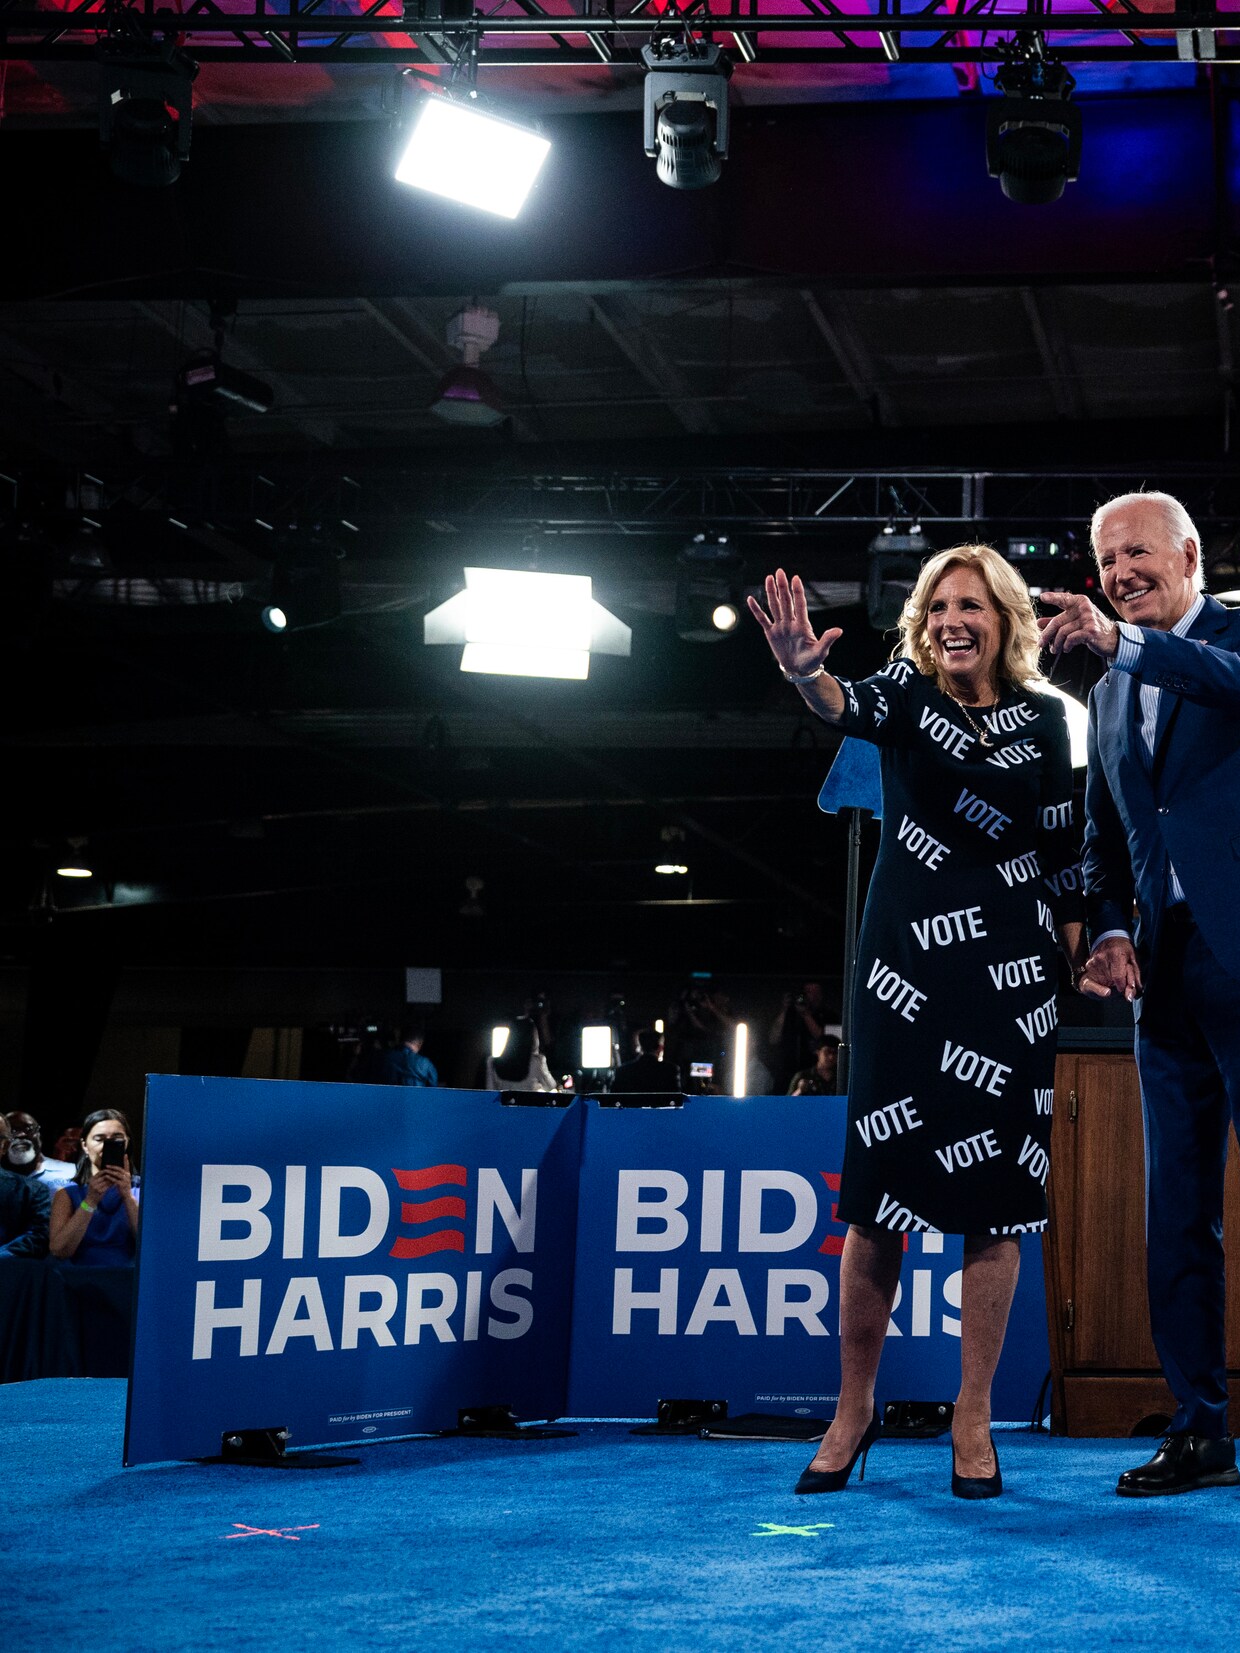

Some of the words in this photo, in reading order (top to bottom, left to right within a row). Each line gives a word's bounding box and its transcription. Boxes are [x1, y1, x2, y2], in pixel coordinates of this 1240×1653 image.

[919, 705, 975, 761] VOTE
[982, 702, 1040, 735] VOTE
[985, 737, 1042, 769] VOTE
[953, 787, 1012, 840] VOTE
[897, 814, 951, 871] VOTE
[1043, 862, 1085, 897] VOT
[911, 905, 988, 951] VOTE
[865, 957, 928, 1023] VOTE
[988, 955, 1046, 991] VOTE
[1015, 993, 1059, 1045] VOTE
[940, 1040, 1013, 1097] VOTE
[855, 1096, 923, 1148] VOTE
[935, 1128, 1003, 1174] VOTE
[197, 1164, 538, 1262] BIDEN
[192, 1268, 534, 1360] HARRIS
[356, 1413, 372, 1421] BIDEN
[383, 1409, 412, 1417] PRESIDENT
